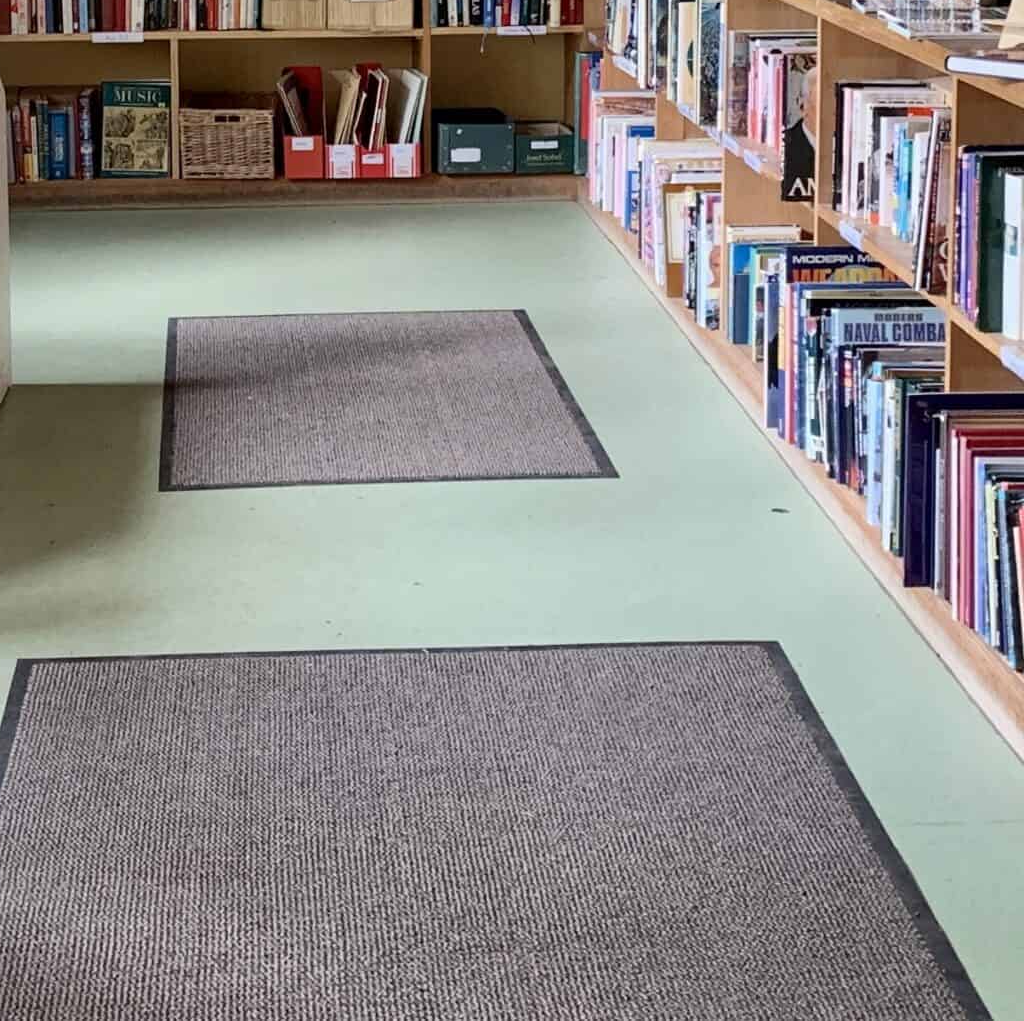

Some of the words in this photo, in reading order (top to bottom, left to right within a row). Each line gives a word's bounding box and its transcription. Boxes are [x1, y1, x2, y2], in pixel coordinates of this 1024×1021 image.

[114, 90, 161, 103] MUSIC
[792, 254, 854, 265] MODERN
[843, 322, 889, 342] NAVAL
[891, 322, 945, 342] COMBA
